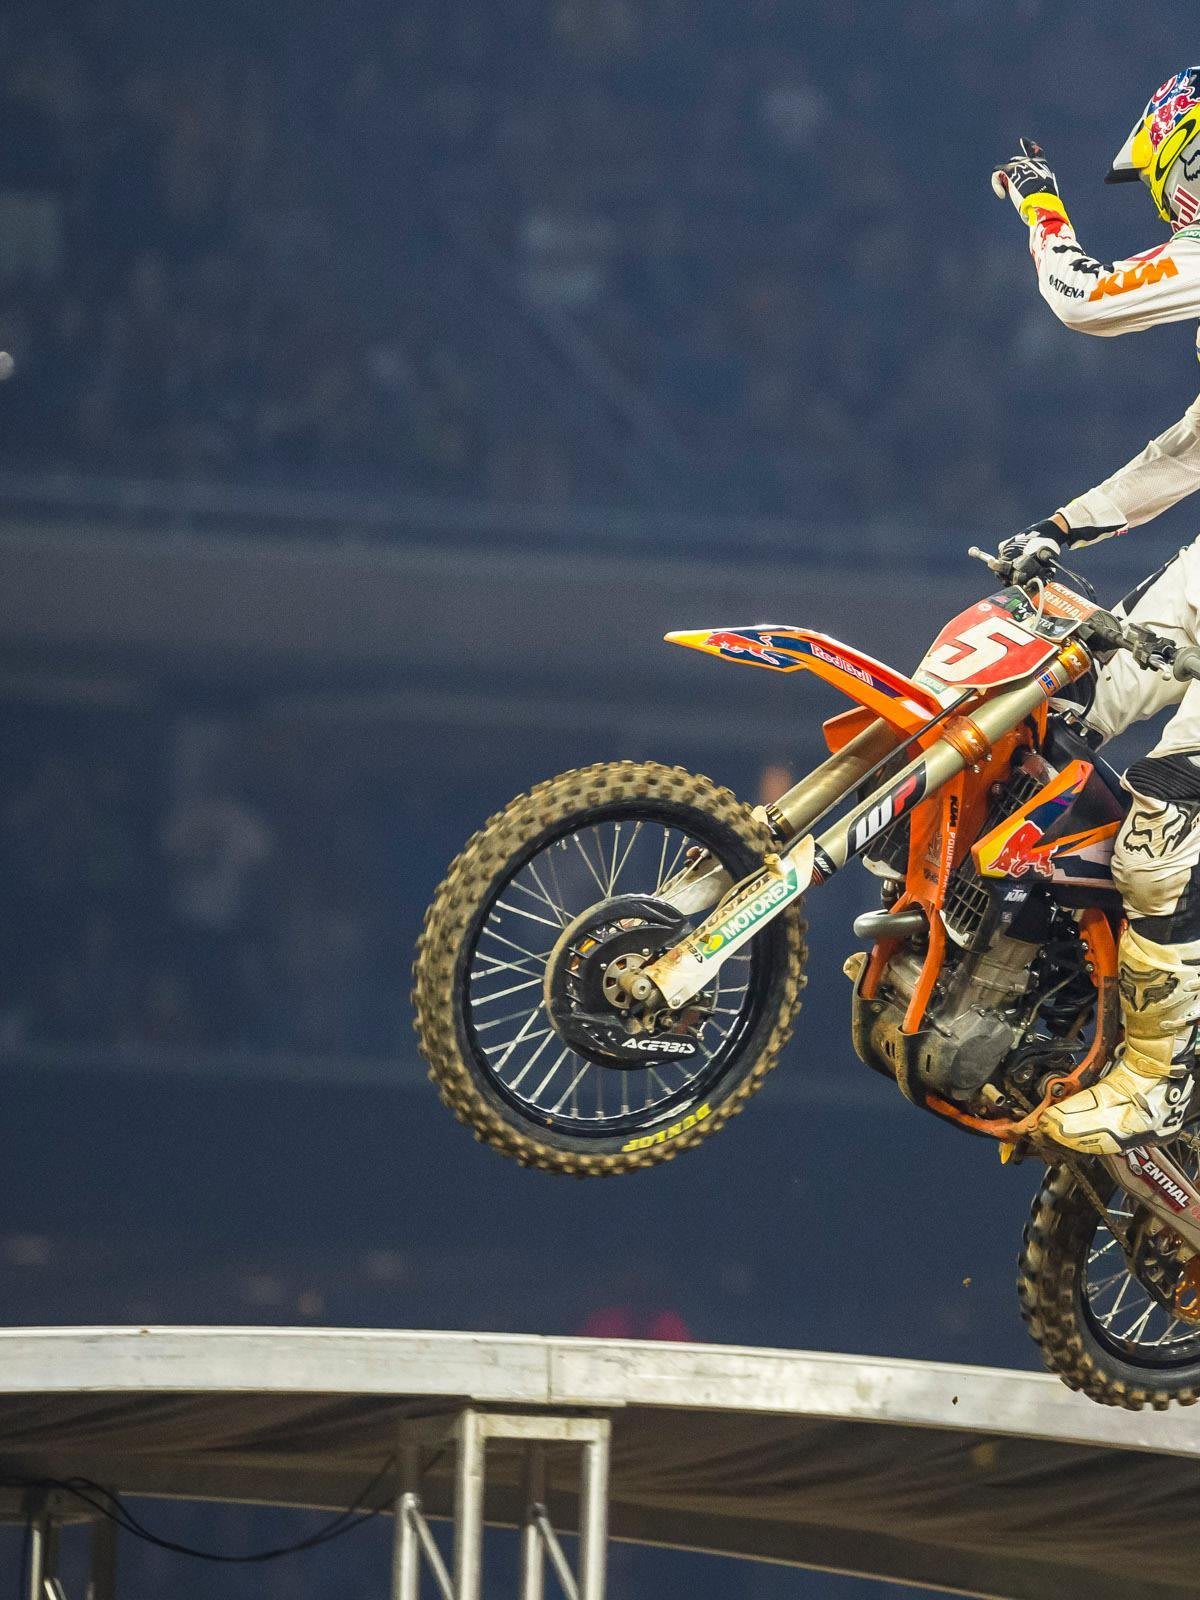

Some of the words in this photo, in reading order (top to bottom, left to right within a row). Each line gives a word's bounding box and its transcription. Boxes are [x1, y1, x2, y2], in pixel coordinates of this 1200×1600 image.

[1053, 276, 1085, 299] ATHENA
[1088, 256, 1179, 302] KTM
[1044, 590, 1084, 621] RENTHAL
[809, 642, 843, 670] Red
[843, 659, 874, 687] Bull
[925, 616, 1038, 682] 5
[855, 774, 917, 850] WP
[720, 879, 796, 939] MOTOREX
[1004, 889, 1028, 902] KTM
[621, 1037, 696, 1054] ACERBIS
